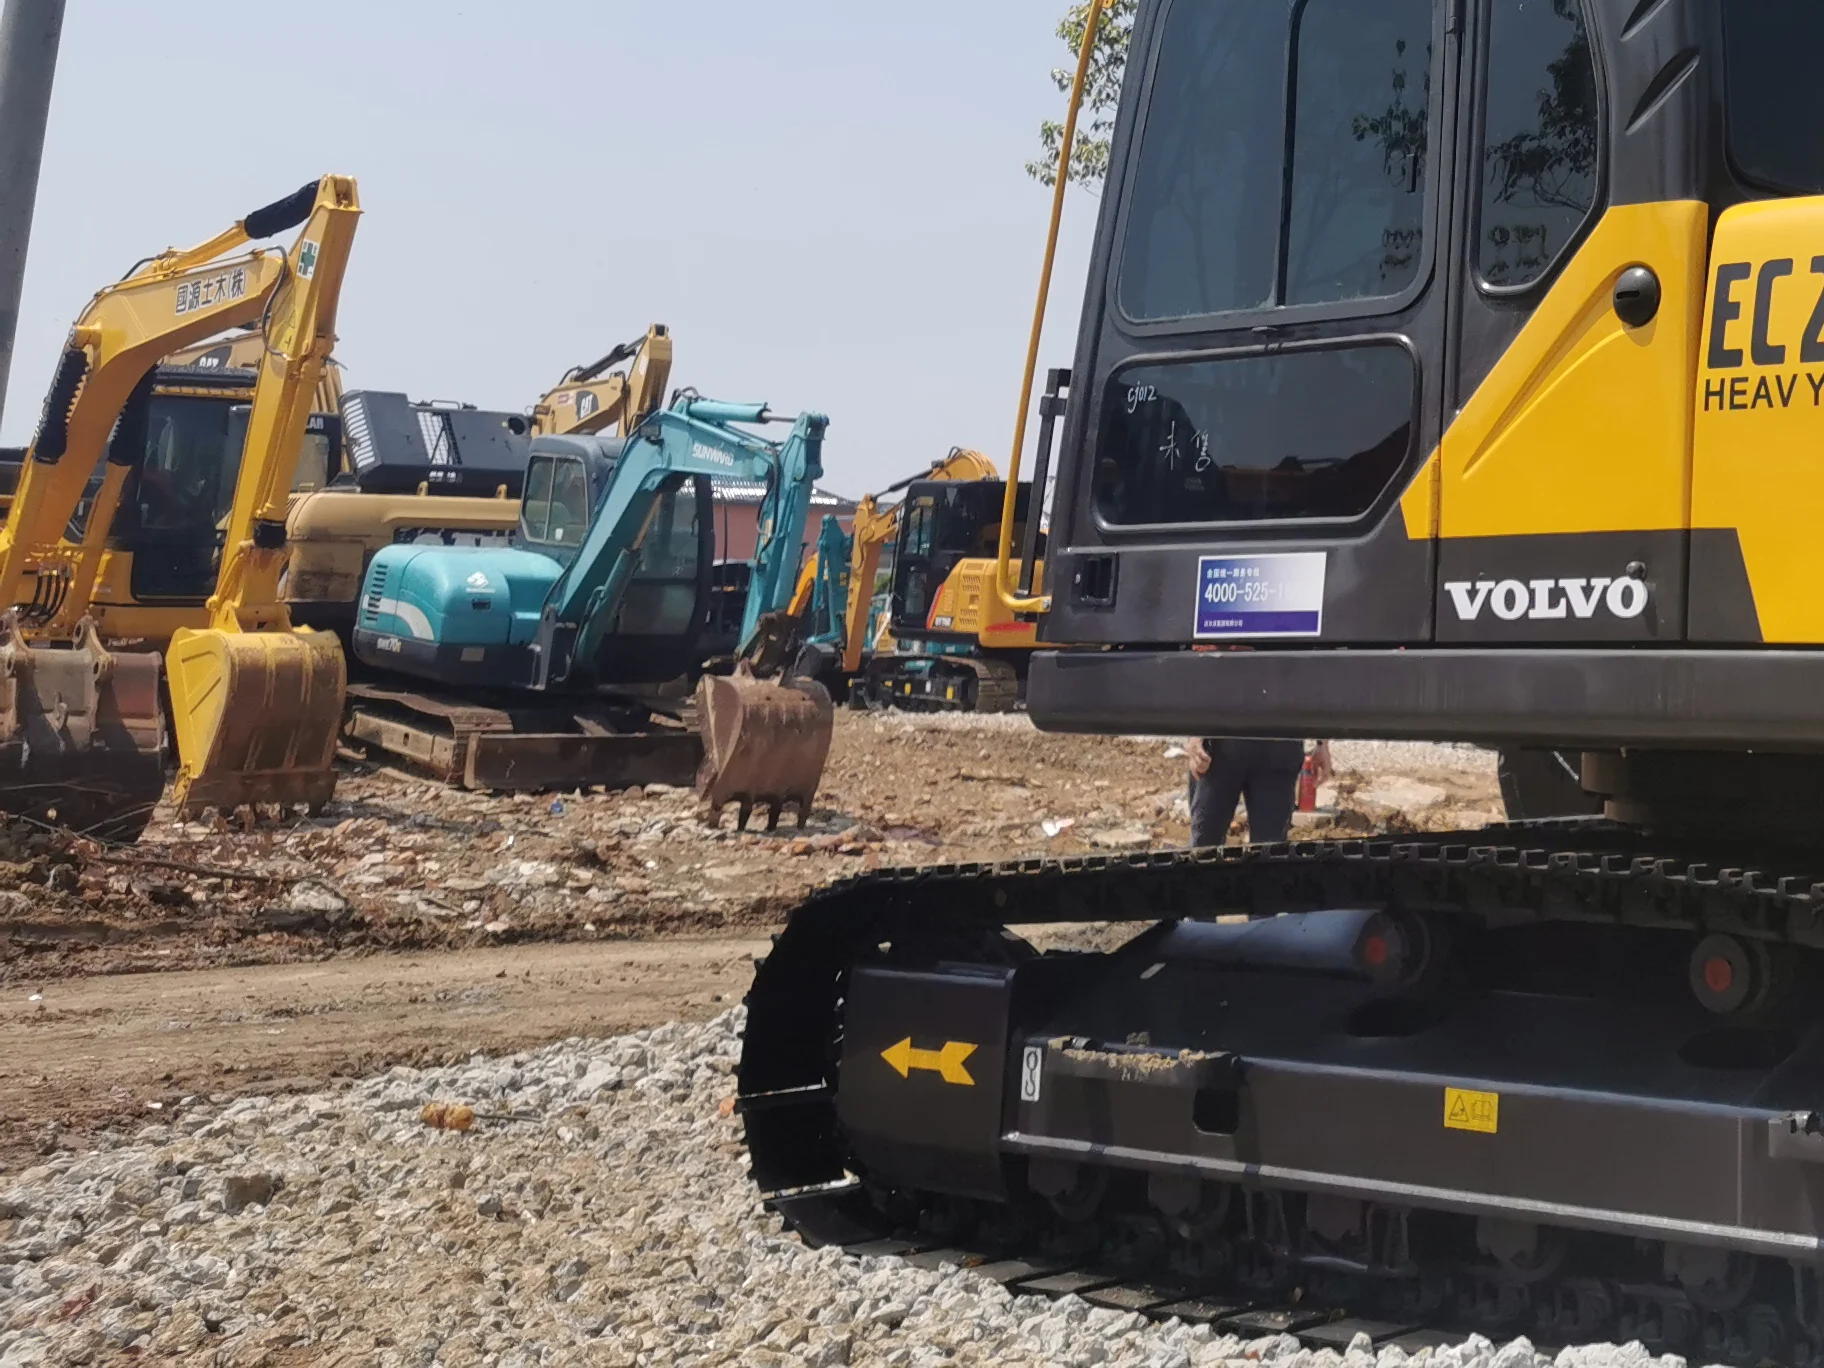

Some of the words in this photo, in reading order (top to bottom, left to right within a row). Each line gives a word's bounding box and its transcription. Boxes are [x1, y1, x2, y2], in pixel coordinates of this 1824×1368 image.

[580, 393, 594, 420] CAT
[1204, 581, 1298, 603] 4000-525-16
[1444, 576, 1648, 620] VOLVO
